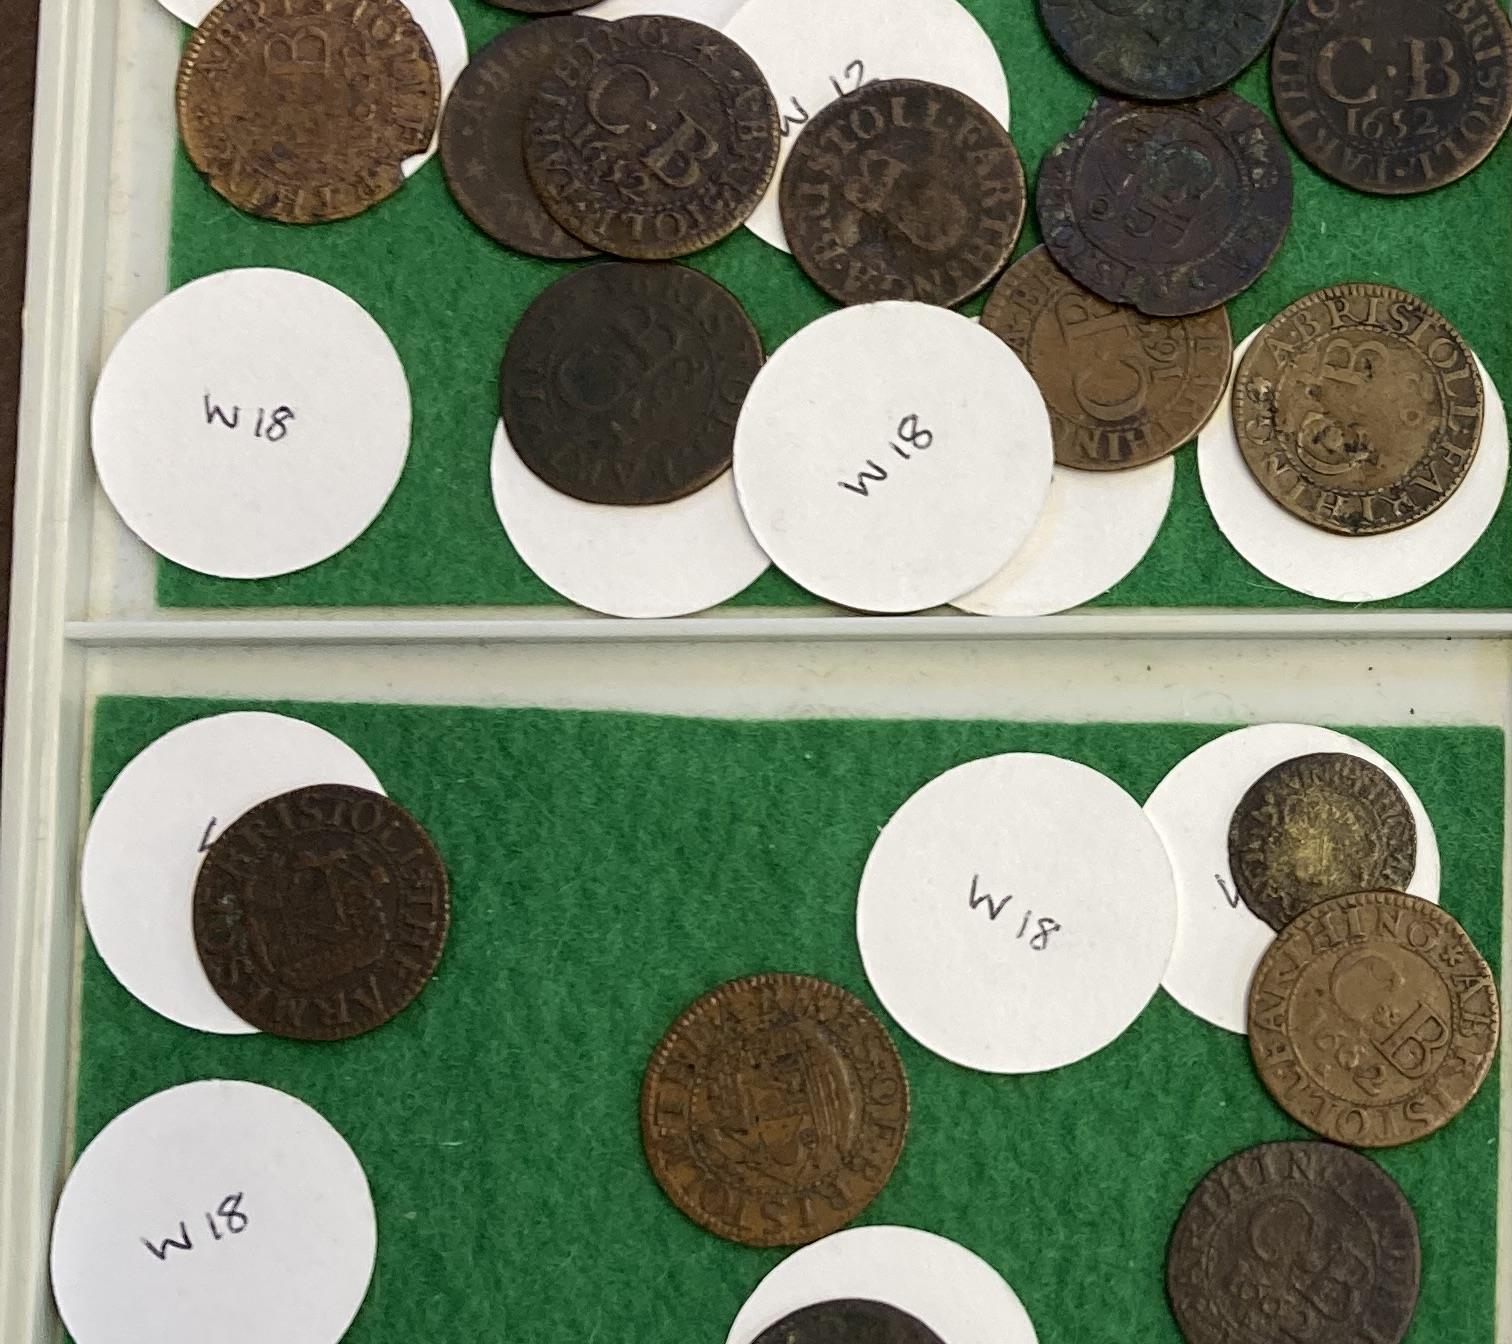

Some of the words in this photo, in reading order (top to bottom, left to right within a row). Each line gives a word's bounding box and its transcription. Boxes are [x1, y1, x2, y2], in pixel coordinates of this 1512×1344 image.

[1280, 289, 1479, 434] BRISTOLL
[203, 393, 241, 430] W
[253, 405, 296, 443] 18
[837, 459, 889, 497] W
[898, 413, 934, 460] 18
[968, 874, 1012, 921] W
[1015, 909, 1062, 952] 18
[141, 1221, 194, 1261] W
[205, 1191, 249, 1241] 18
